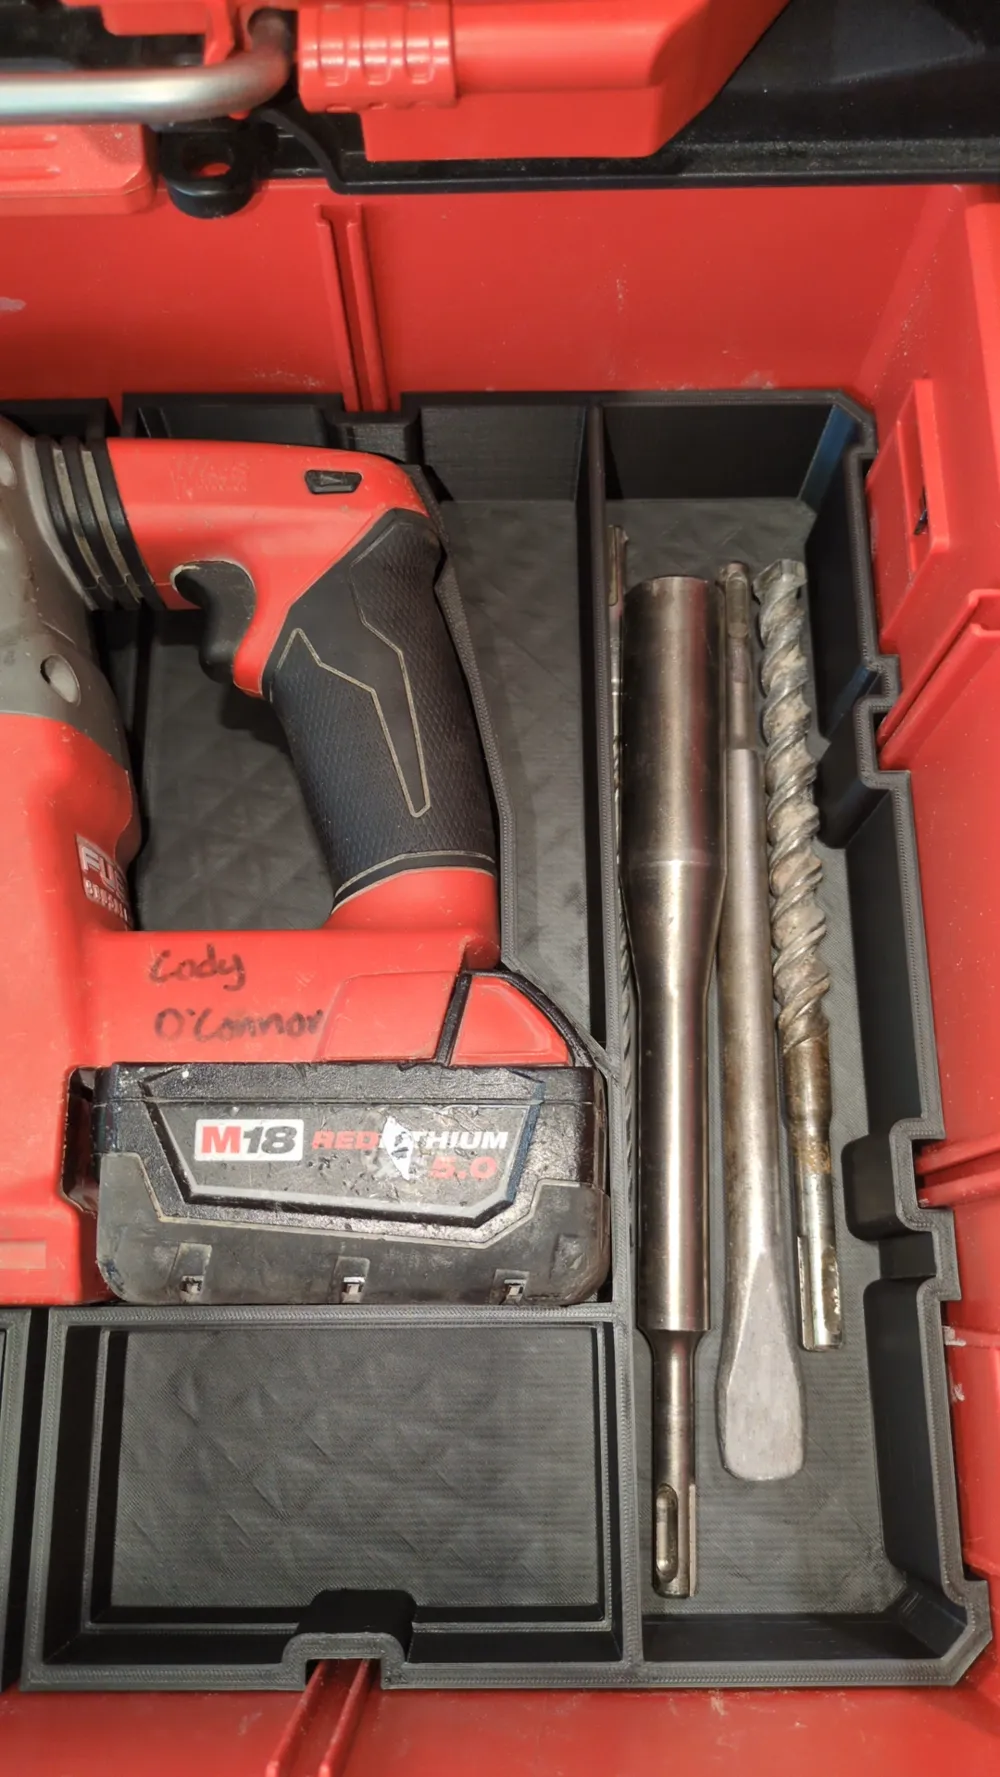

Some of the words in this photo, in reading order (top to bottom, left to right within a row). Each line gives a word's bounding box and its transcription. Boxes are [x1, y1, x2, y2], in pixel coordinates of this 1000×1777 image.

[149, 943, 246, 991] Cody
[155, 1007, 324, 1041] O'Connor
[201, 1126, 298, 1154] M18
[312, 1130, 508, 1151] REDTHIUM
[430, 1156, 497, 1180] 5.0
